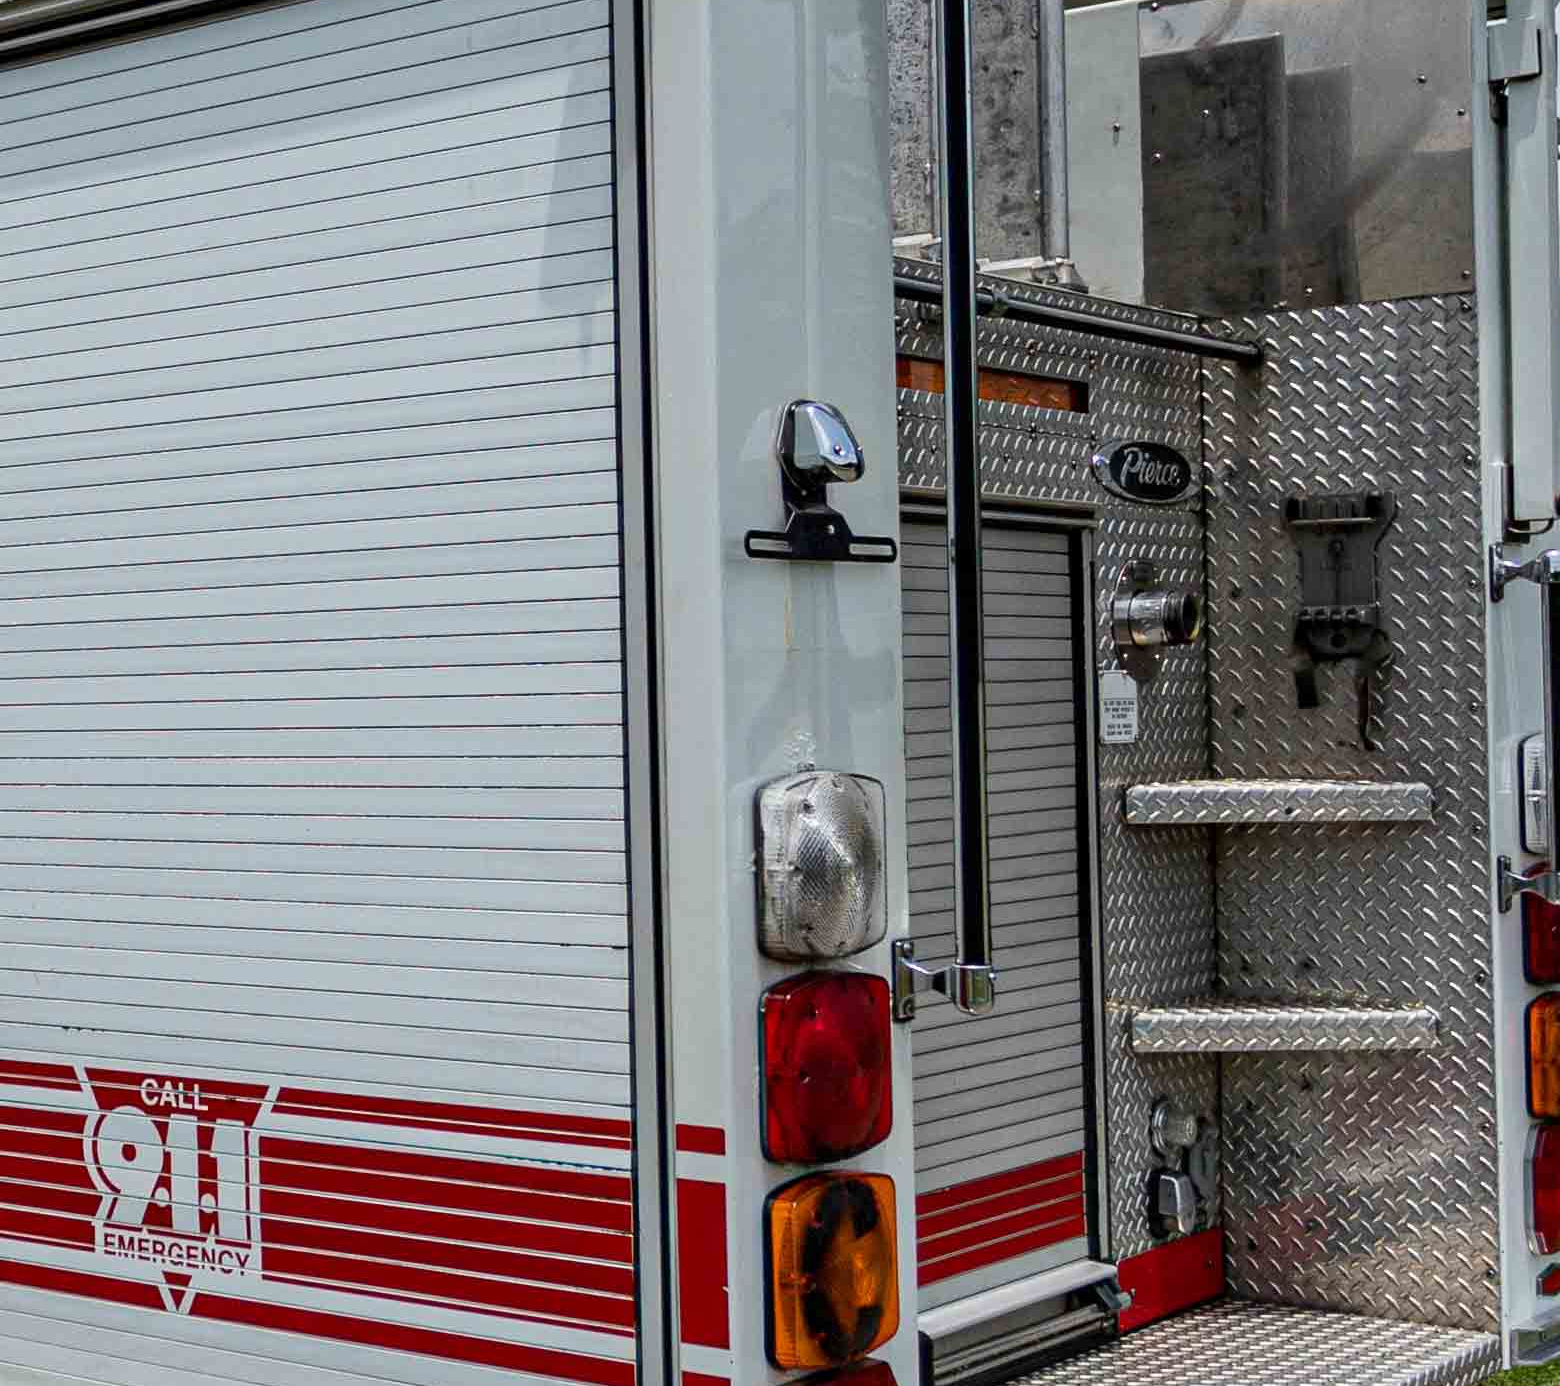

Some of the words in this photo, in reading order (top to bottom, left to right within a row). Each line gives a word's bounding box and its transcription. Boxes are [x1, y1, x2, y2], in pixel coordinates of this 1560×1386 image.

[1120, 447, 1180, 487] Pierce
[140, 1078, 209, 1111] CALL
[97, 1105, 248, 1239] 911
[103, 1232, 250, 1276] EMERGENCY
